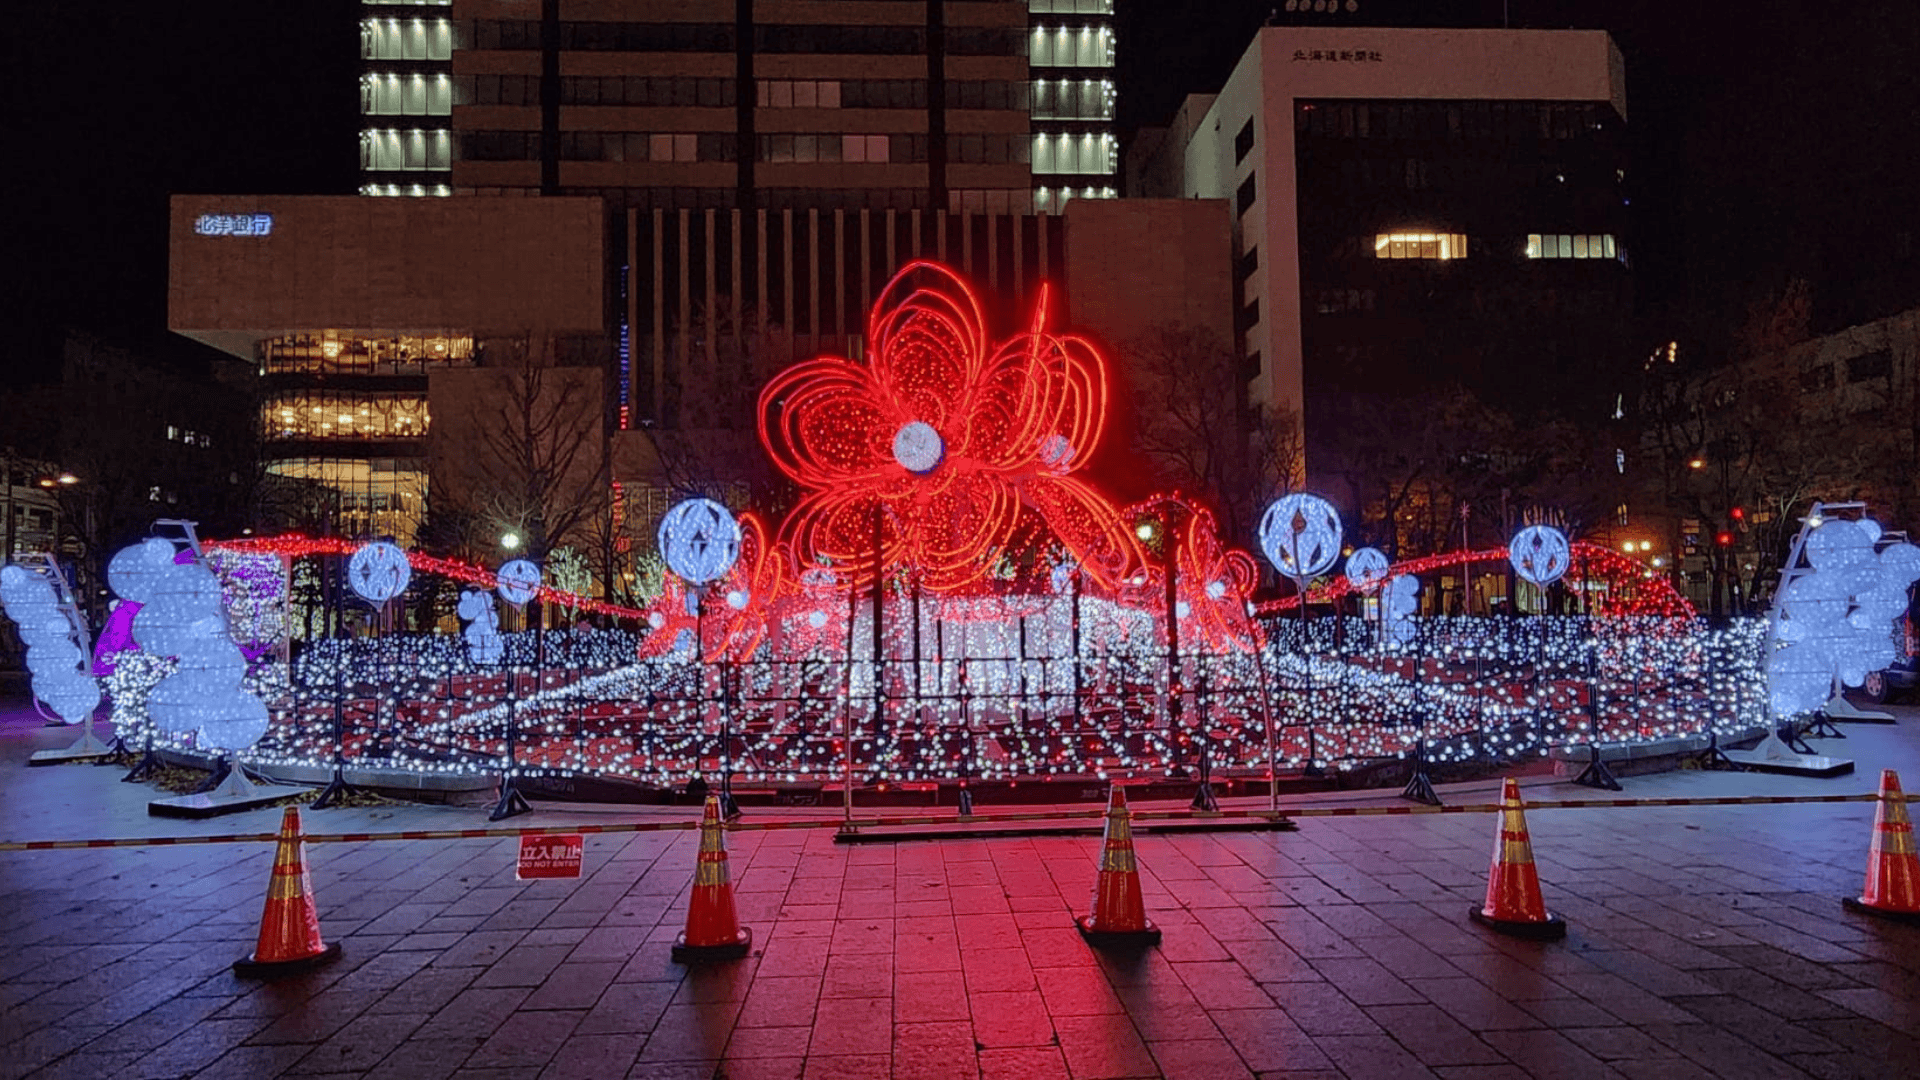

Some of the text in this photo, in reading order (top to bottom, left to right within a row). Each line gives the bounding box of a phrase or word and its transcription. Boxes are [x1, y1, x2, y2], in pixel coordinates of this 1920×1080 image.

[194, 214, 272, 236] 北洋銀行
[521, 845, 581, 860] 立入禁止
[552, 860, 580, 868] ENTER
